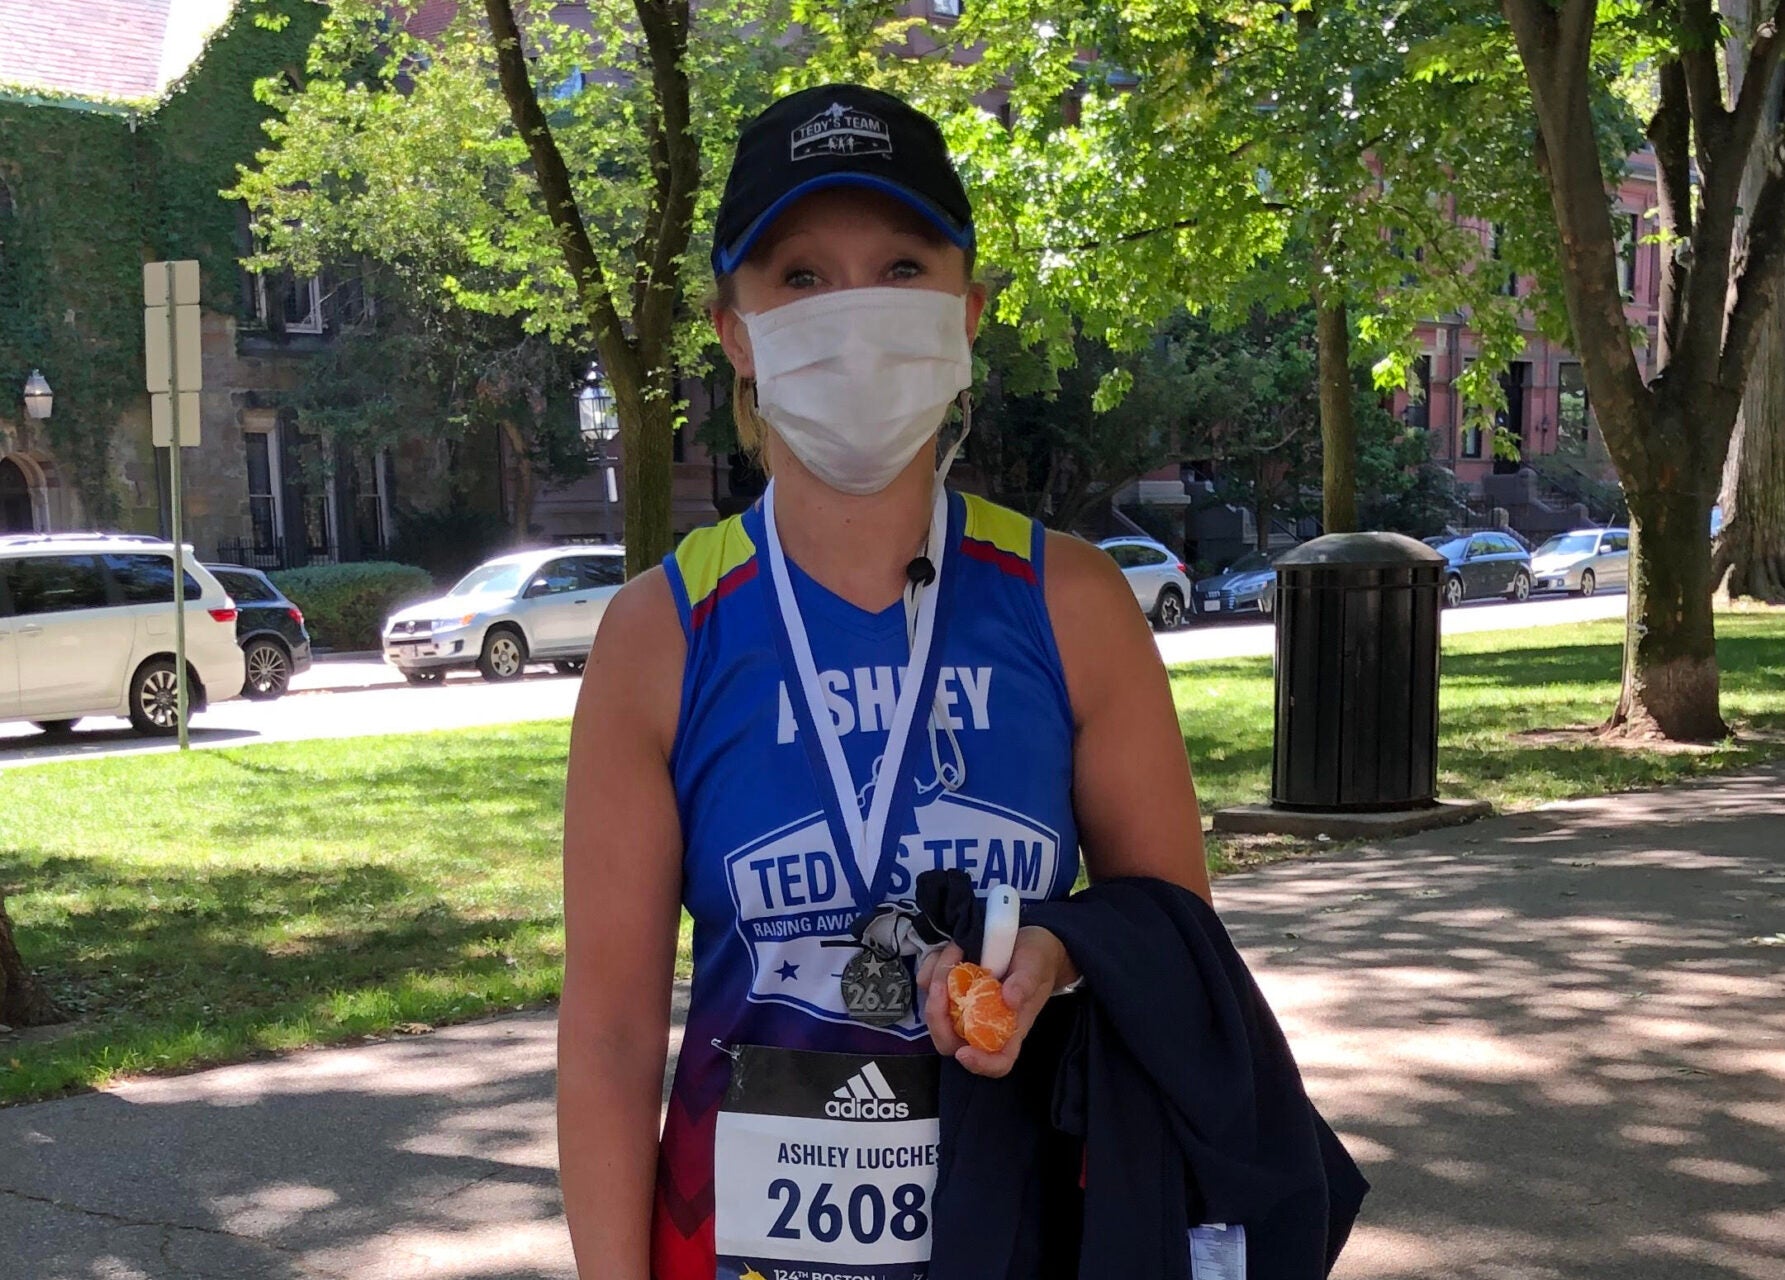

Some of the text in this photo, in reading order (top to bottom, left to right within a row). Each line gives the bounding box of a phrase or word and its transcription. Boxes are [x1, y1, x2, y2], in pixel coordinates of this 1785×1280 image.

[800, 115, 881, 138] TEDY'S TEAM
[777, 666, 992, 744] SHEY
[752, 912, 862, 937] RAISING AWA
[848, 982, 904, 1011] 26.2
[825, 1097, 909, 1120] adidas
[777, 1142, 850, 1169] ASHLEY
[766, 1178, 929, 1245] 2608
